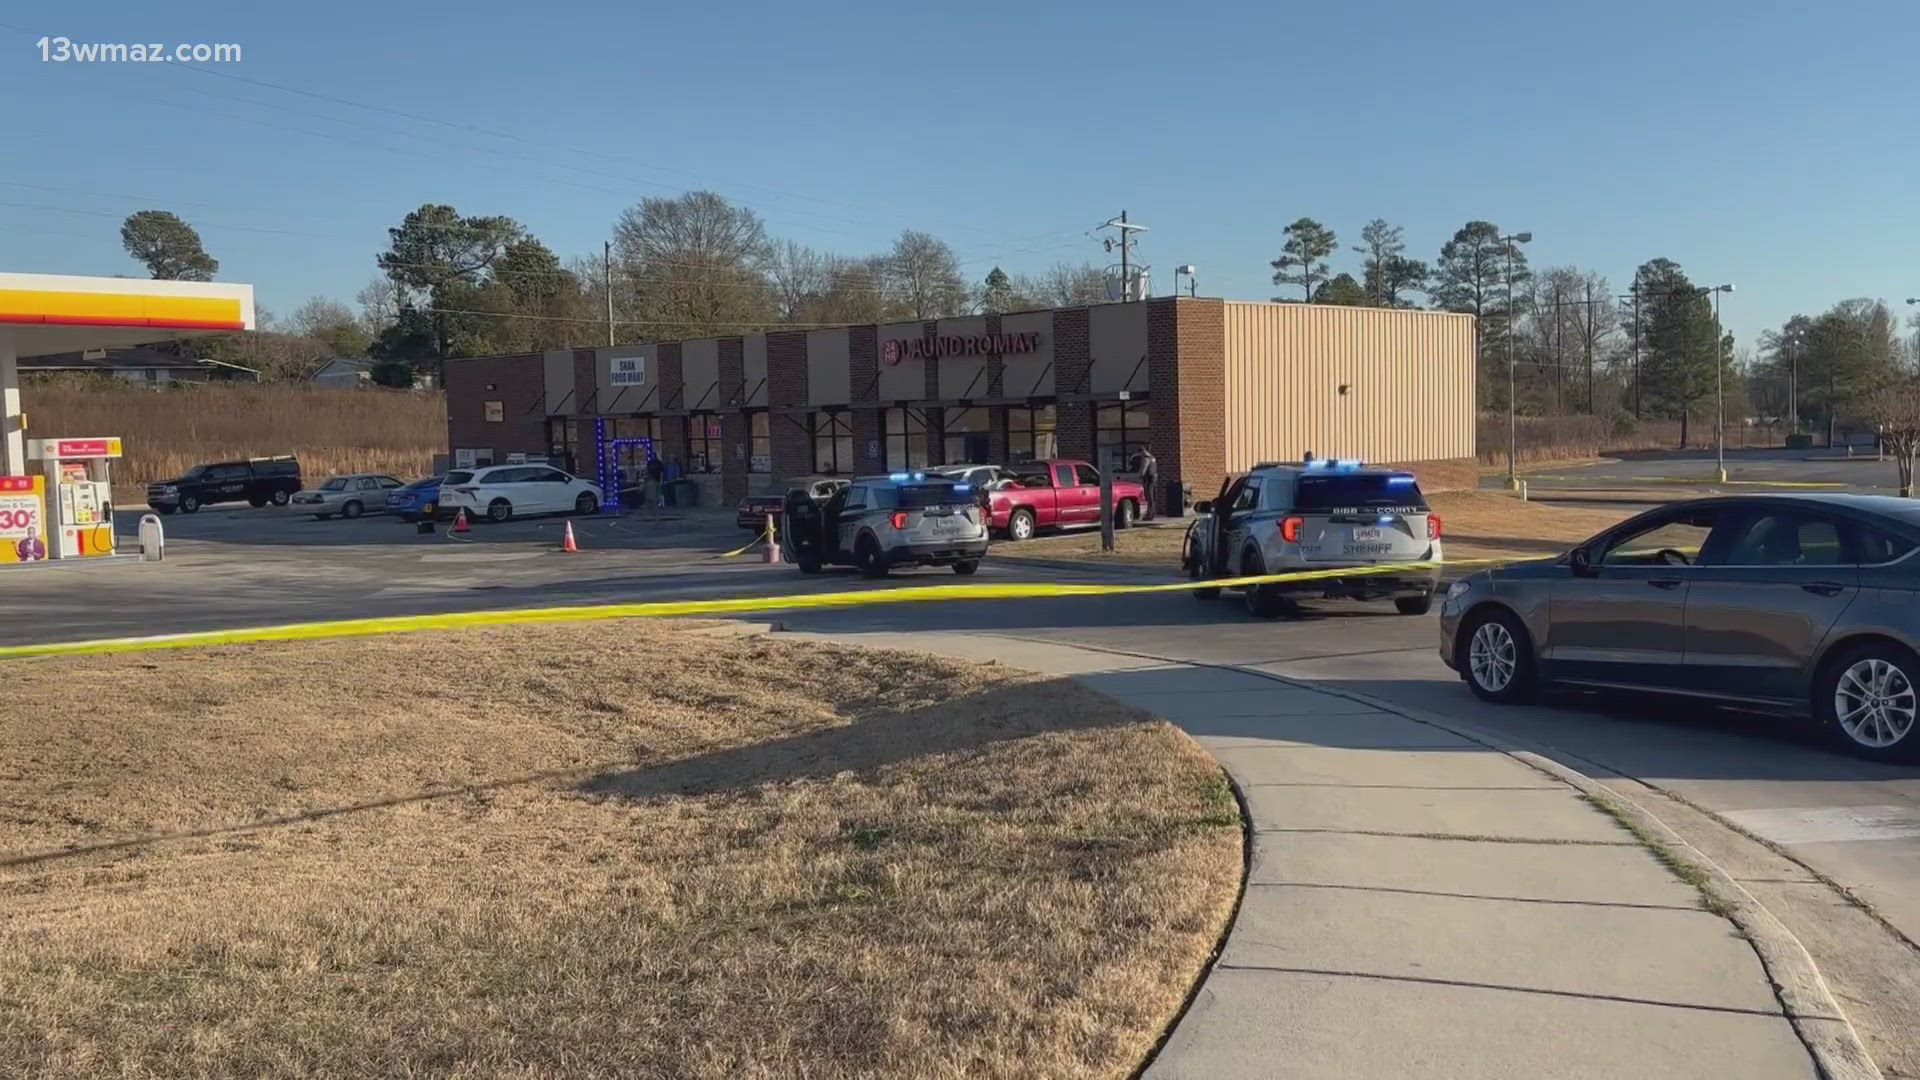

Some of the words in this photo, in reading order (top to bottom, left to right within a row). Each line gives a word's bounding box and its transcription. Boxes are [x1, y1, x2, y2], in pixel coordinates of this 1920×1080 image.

[885, 342, 896, 351] 24
[900, 332, 1039, 359] LAUNDROMAT
[885, 351, 897, 362] HR
[611, 372, 627, 384] FOOD
[628, 371, 644, 383] MART
[1333, 507, 1358, 515] BIBB
[1343, 543, 1392, 554] SHERIFF
